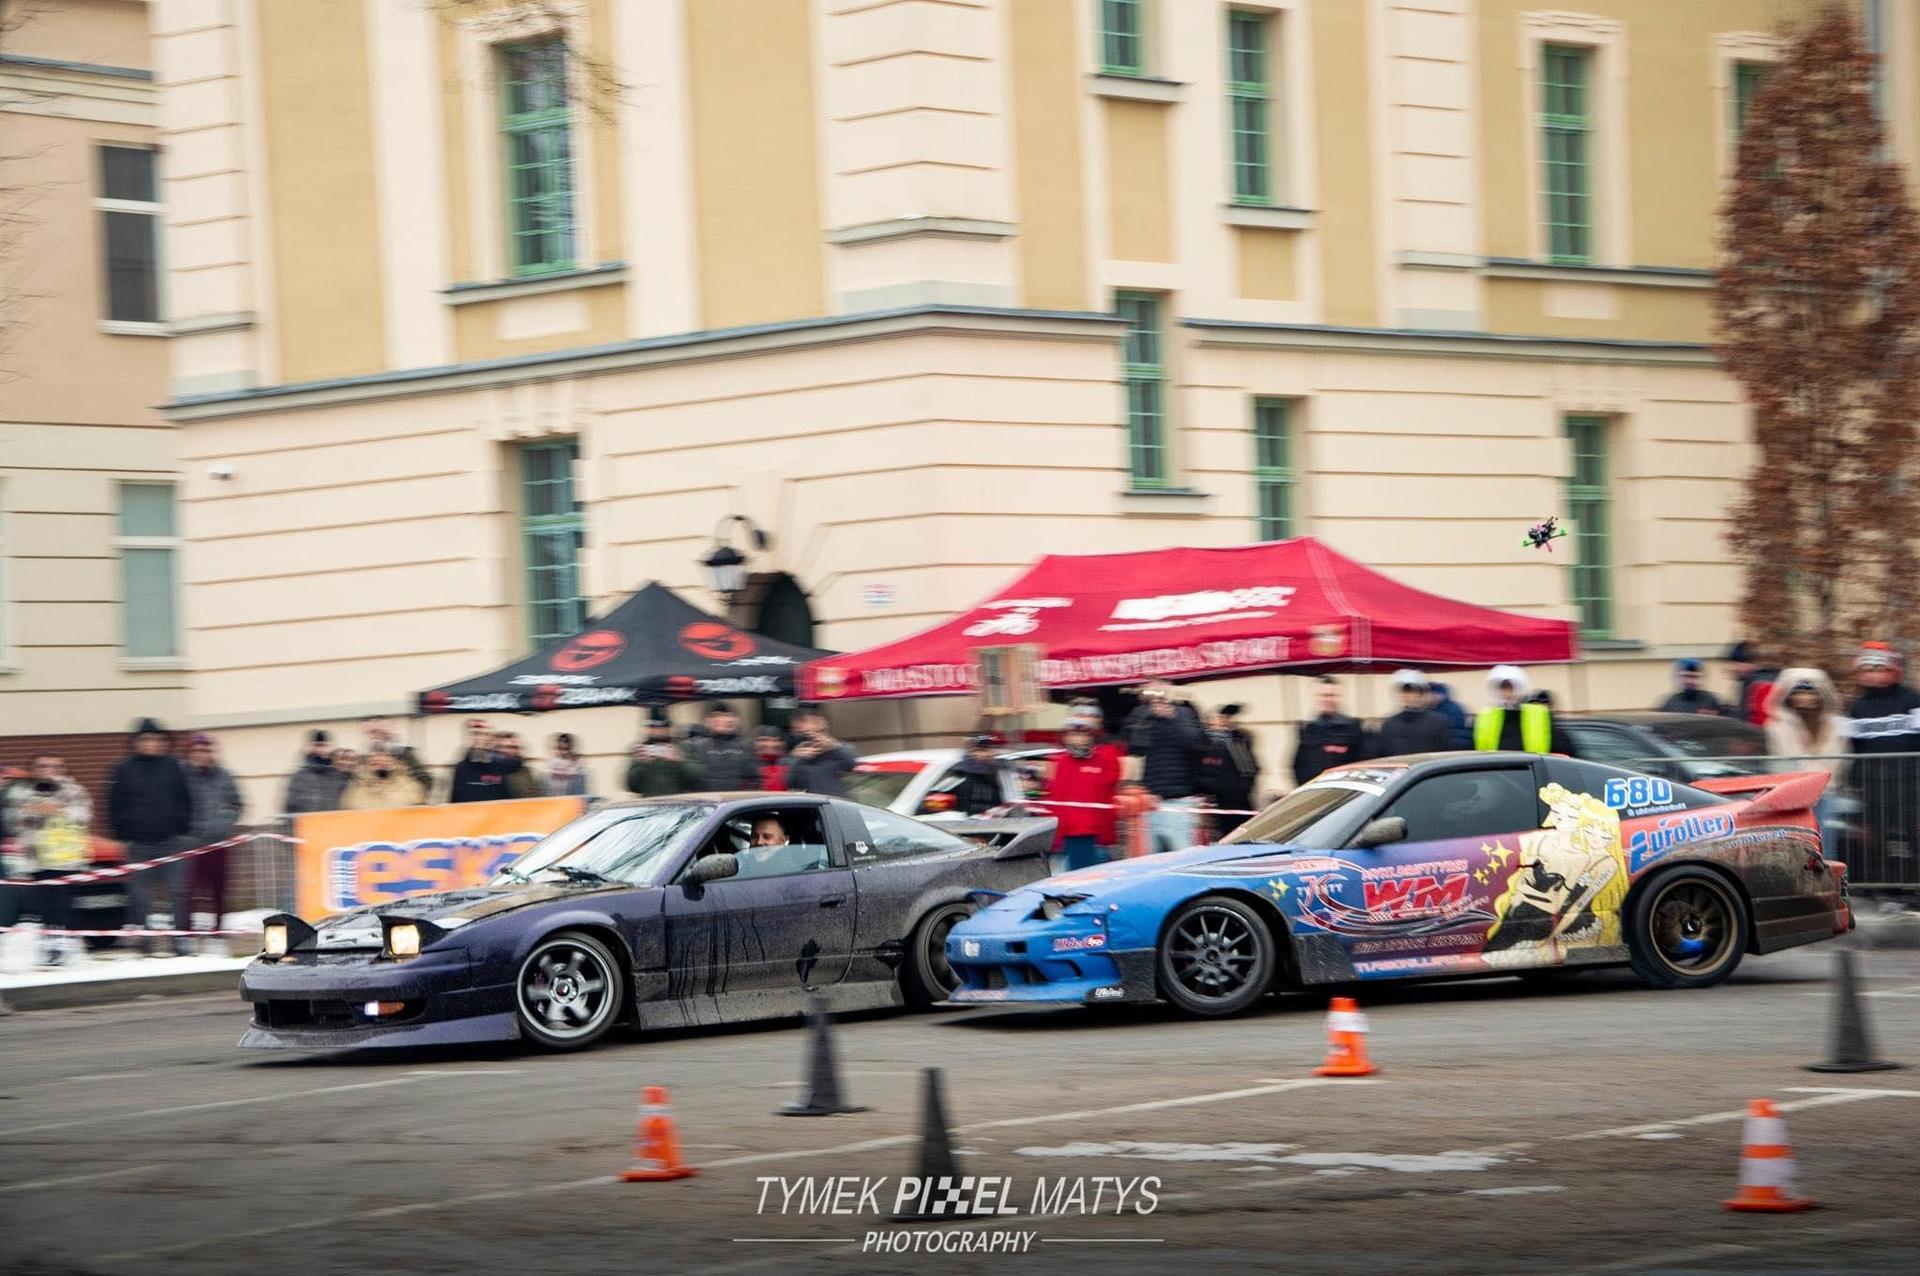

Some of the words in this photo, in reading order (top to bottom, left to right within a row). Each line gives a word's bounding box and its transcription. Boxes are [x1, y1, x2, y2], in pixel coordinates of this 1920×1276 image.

[1605, 777, 1672, 809] 680
[1629, 814, 1731, 874] Euroller
[1363, 873, 1470, 912] WM
